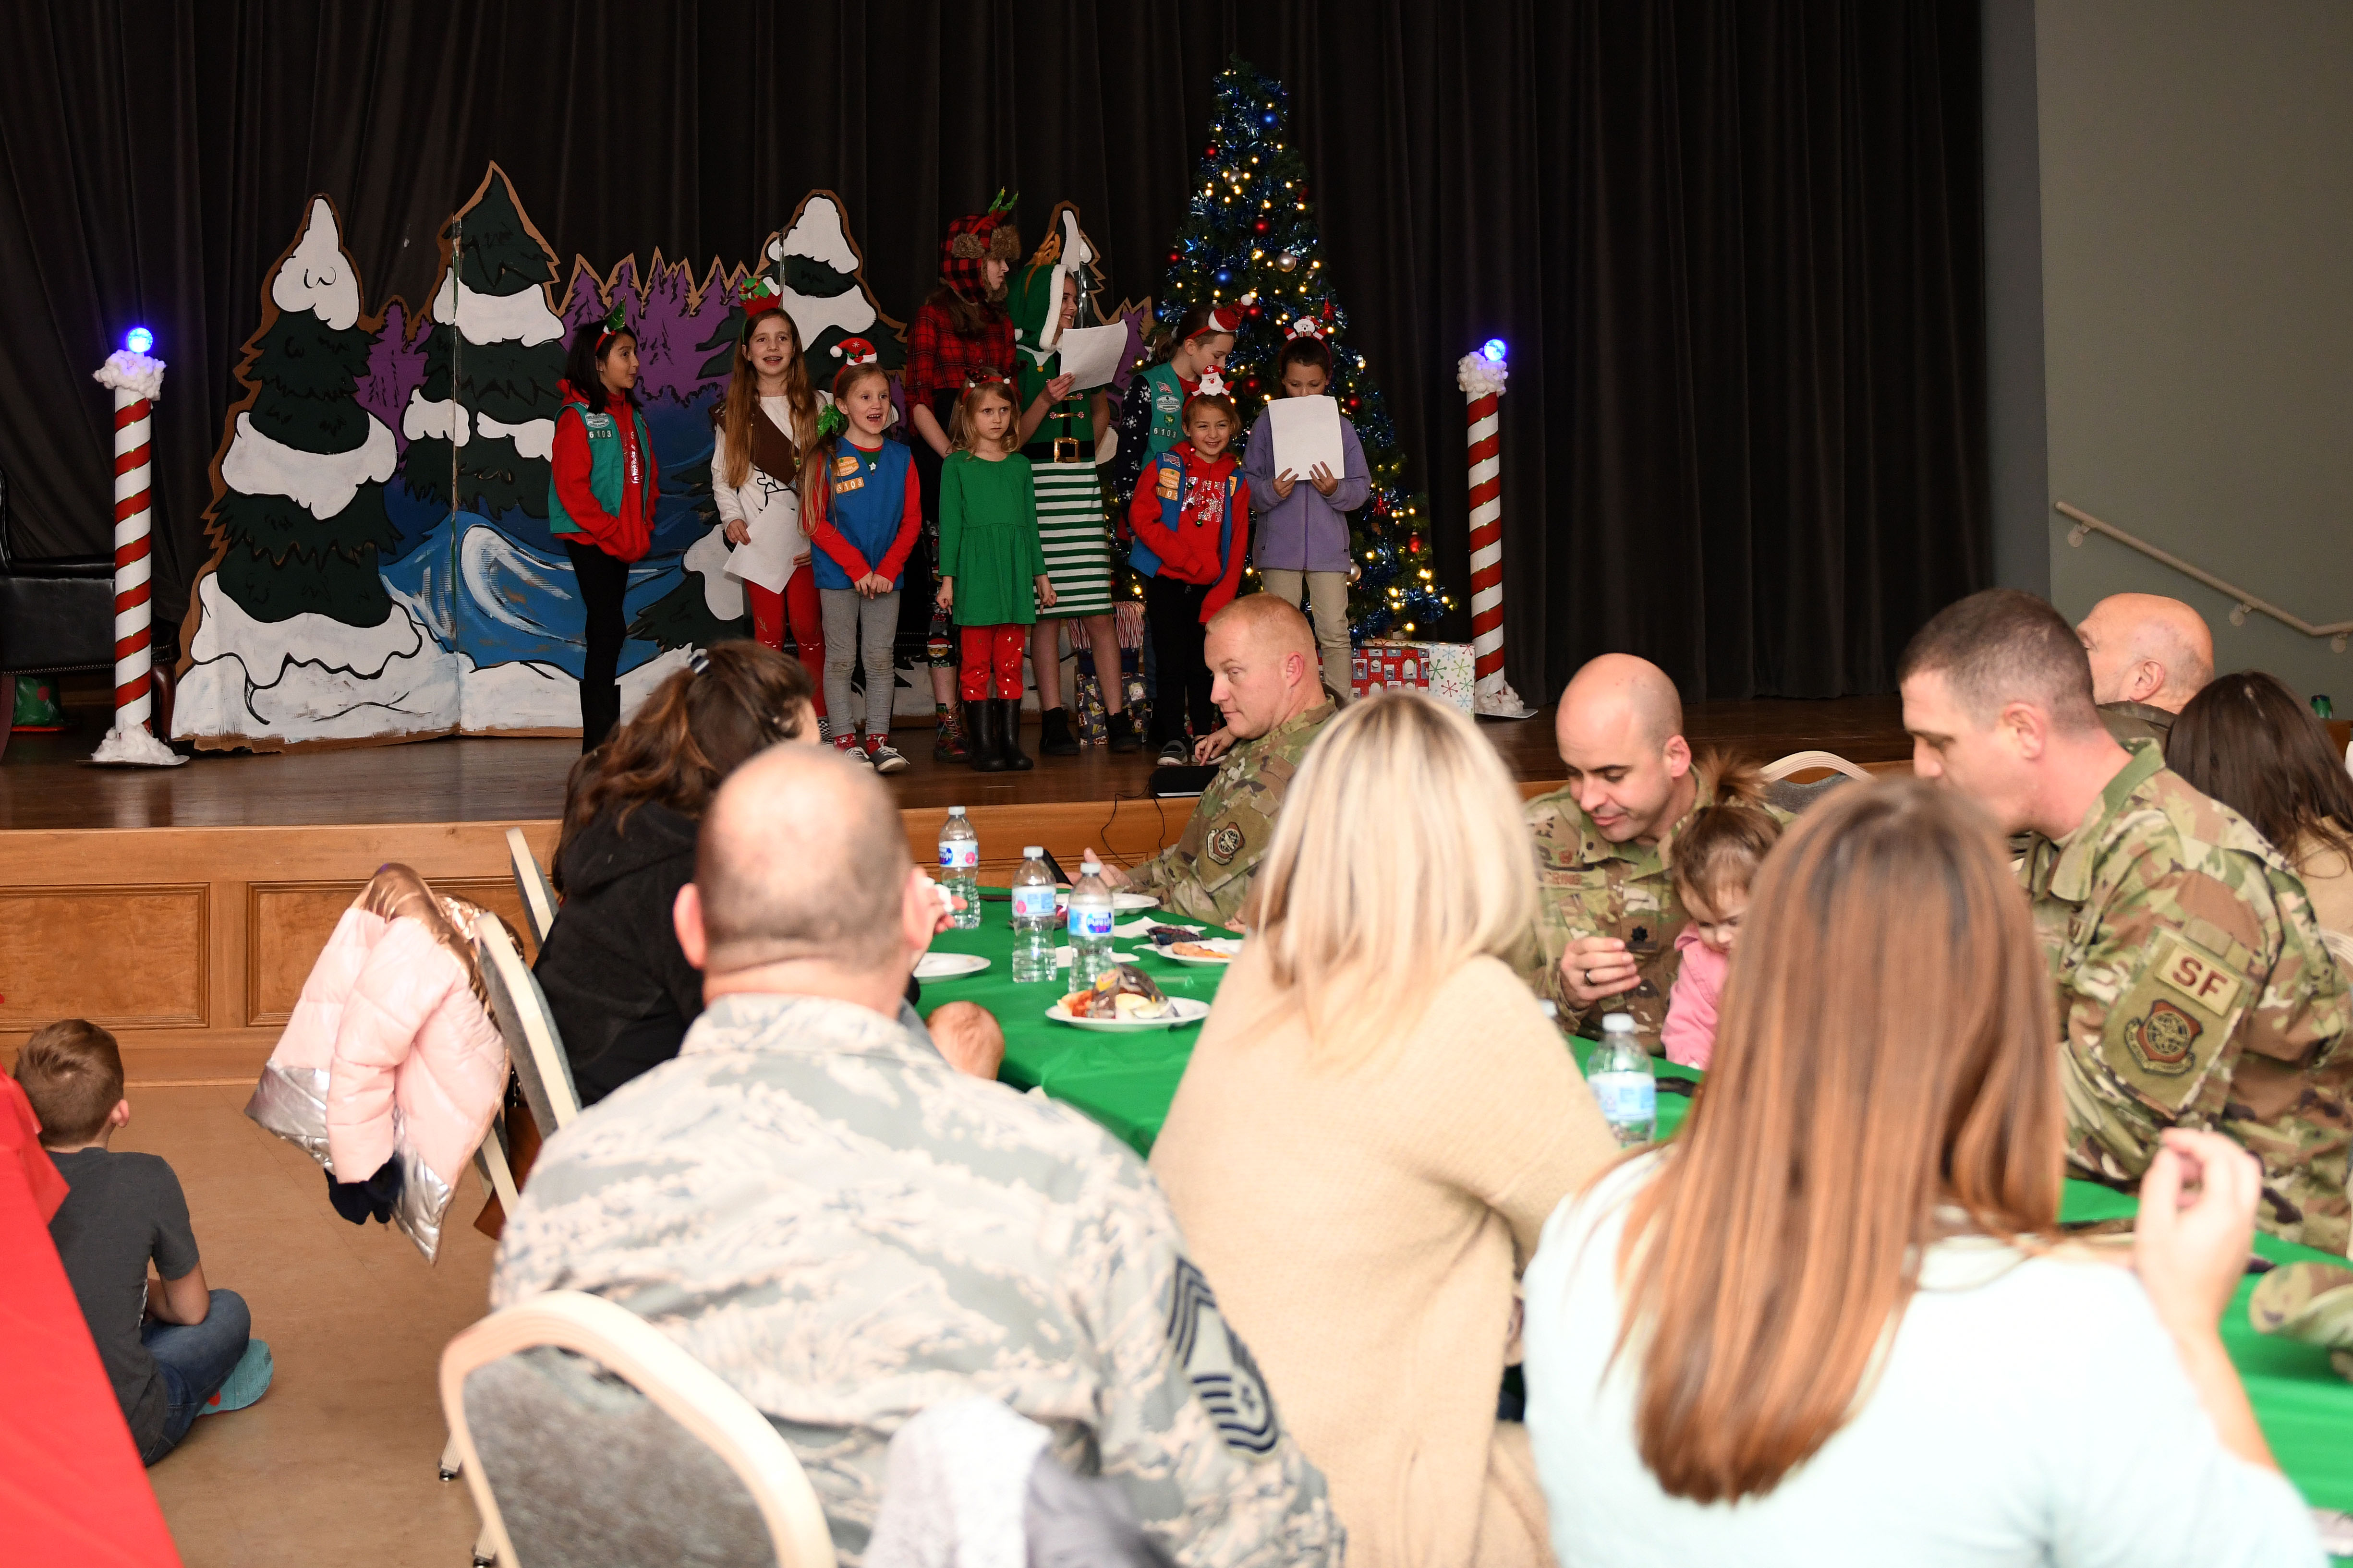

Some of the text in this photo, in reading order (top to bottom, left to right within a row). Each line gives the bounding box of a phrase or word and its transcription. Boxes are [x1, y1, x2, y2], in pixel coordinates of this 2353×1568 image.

[589, 430, 611, 438] 6103
[1153, 427, 1176, 438] 6103
[837, 479, 862, 492] 6103
[2173, 957, 2228, 996] SF
